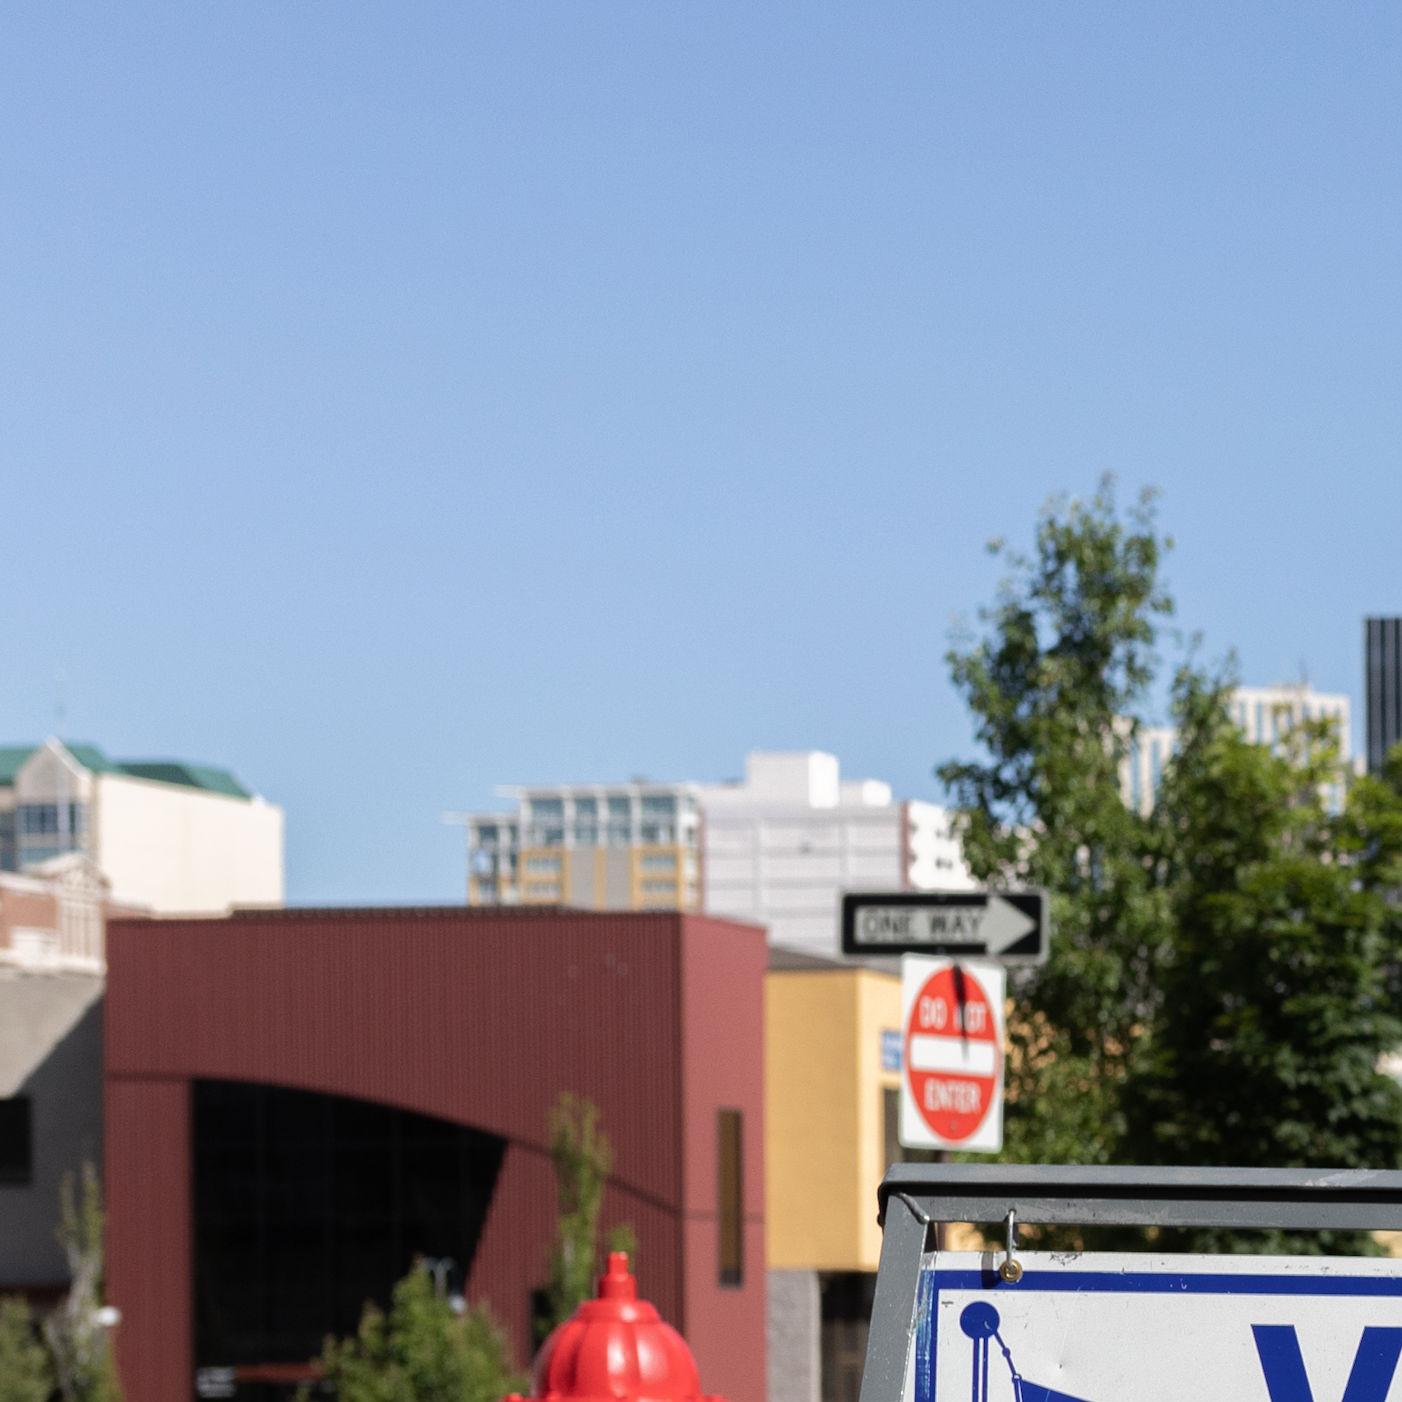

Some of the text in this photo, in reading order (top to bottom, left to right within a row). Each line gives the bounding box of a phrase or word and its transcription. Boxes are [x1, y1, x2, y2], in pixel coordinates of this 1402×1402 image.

[862, 908, 984, 942] ONE WAY
[919, 996, 947, 1030] DO
[924, 1078, 982, 1114] ENTER
